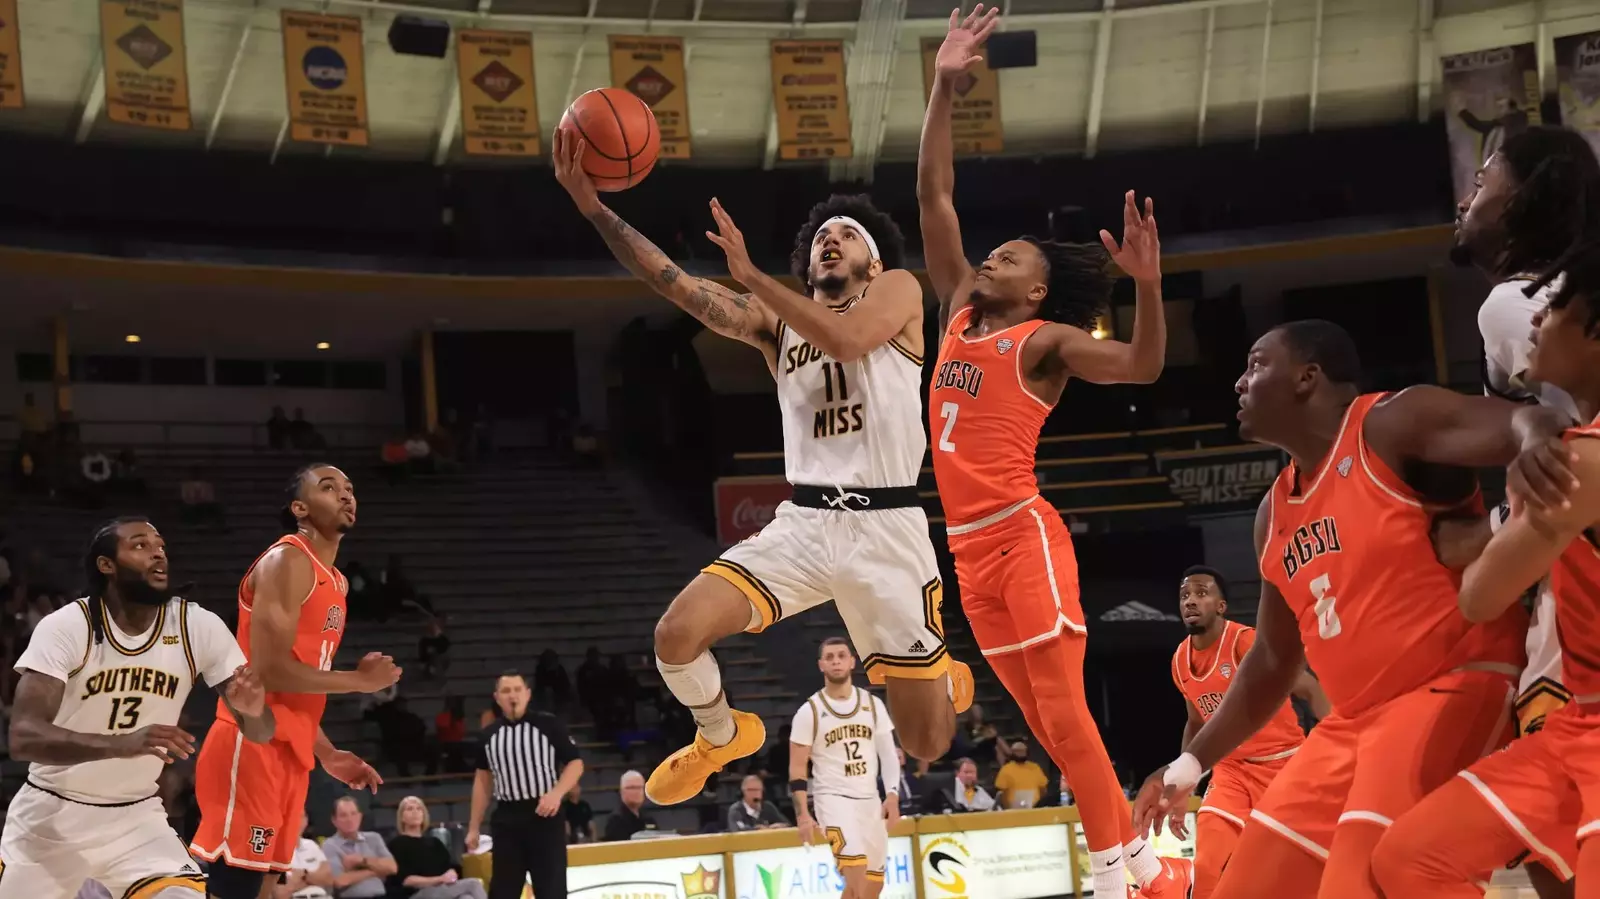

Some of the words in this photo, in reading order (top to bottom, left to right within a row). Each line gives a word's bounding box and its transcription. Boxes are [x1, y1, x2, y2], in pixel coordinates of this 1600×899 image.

[822, 361, 848, 403] 11
[935, 360, 984, 399] BGSU
[814, 404, 863, 439] MISS
[939, 401, 959, 453] 2
[1170, 460, 1278, 489] SOUTHERN
[1201, 484, 1242, 505] MISS
[1282, 516, 1342, 583] BGSU
[81, 667, 179, 700] SOUTHERN
[108, 697, 143, 730] 13
[824, 724, 873, 748] SOUTHERN
[843, 740, 863, 761] 12
[844, 761, 867, 777] MISS
